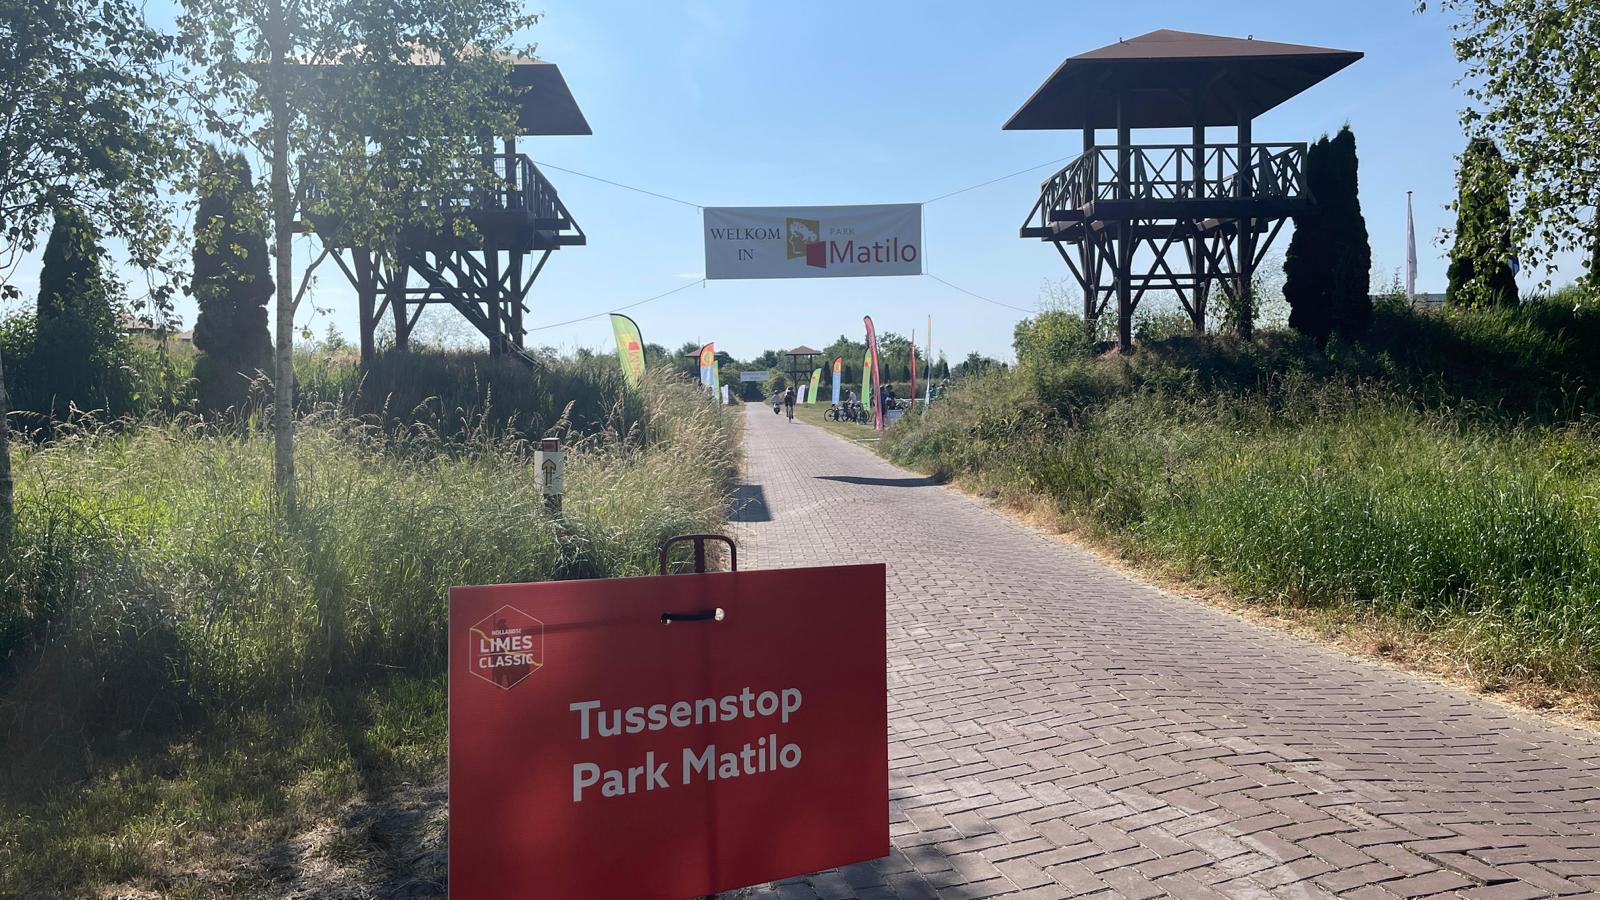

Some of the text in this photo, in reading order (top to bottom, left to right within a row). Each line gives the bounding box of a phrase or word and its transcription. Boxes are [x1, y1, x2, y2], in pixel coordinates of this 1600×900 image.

[710, 228, 781, 241] WELKOM
[829, 227, 856, 236] PARK
[737, 249, 754, 261] IN
[830, 236, 918, 265] Matilo
[480, 635, 533, 653] LIMES
[478, 653, 534, 669] CLASSIC
[569, 686, 803, 741] Tussenstop
[572, 733, 802, 803] Park Matilo
